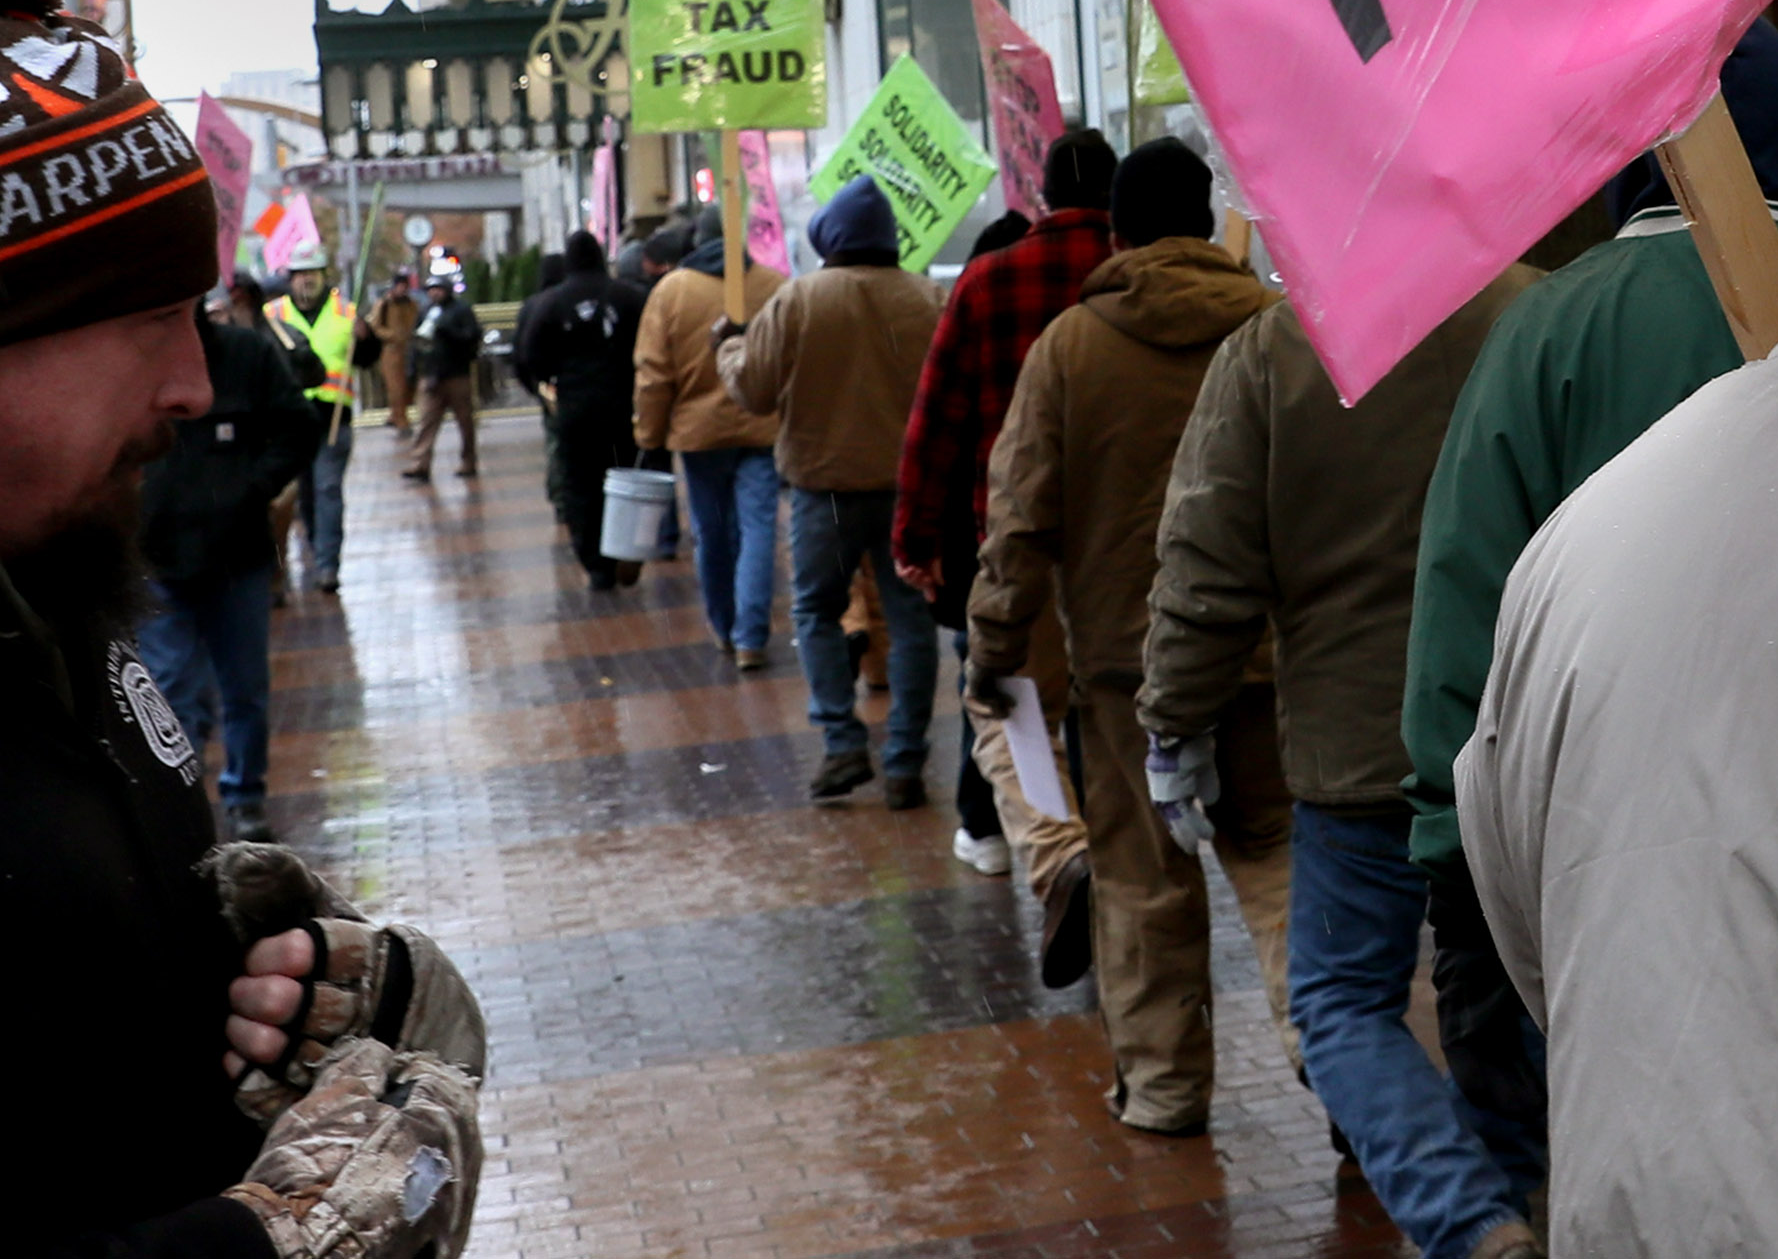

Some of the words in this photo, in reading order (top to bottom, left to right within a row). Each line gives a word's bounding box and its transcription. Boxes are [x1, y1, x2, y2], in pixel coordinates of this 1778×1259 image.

[683, 0, 772, 33] TAX
[652, 49, 806, 88] FRAUD
[883, 94, 967, 200] SOLIDARITY
